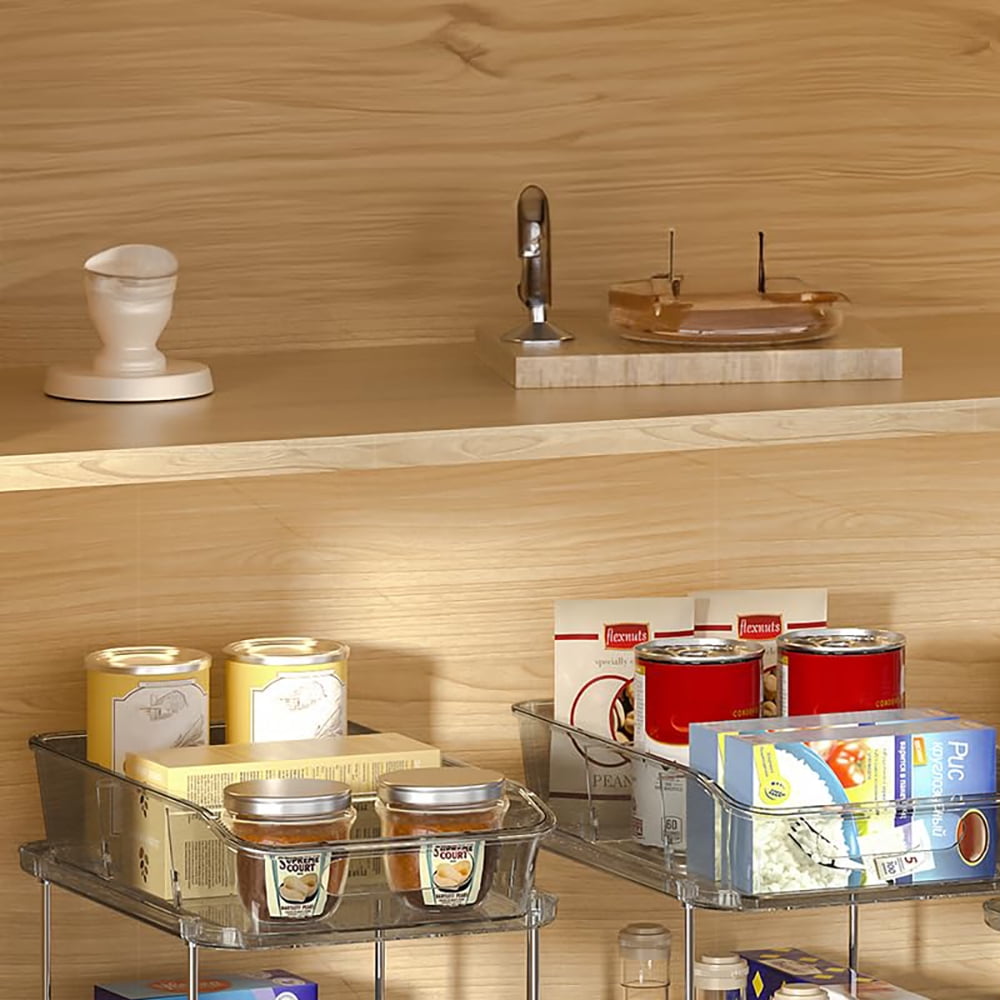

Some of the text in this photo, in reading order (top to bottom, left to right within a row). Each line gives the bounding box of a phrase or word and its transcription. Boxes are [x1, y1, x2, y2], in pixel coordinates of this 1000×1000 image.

[740, 618, 781, 637] flexnuts
[606, 628, 648, 646] flexnuts
[948, 740, 969, 781] Рис
[593, 774, 635, 790] PEAN
[440, 851, 468, 860] COURT
[287, 863, 316, 872] COURT
